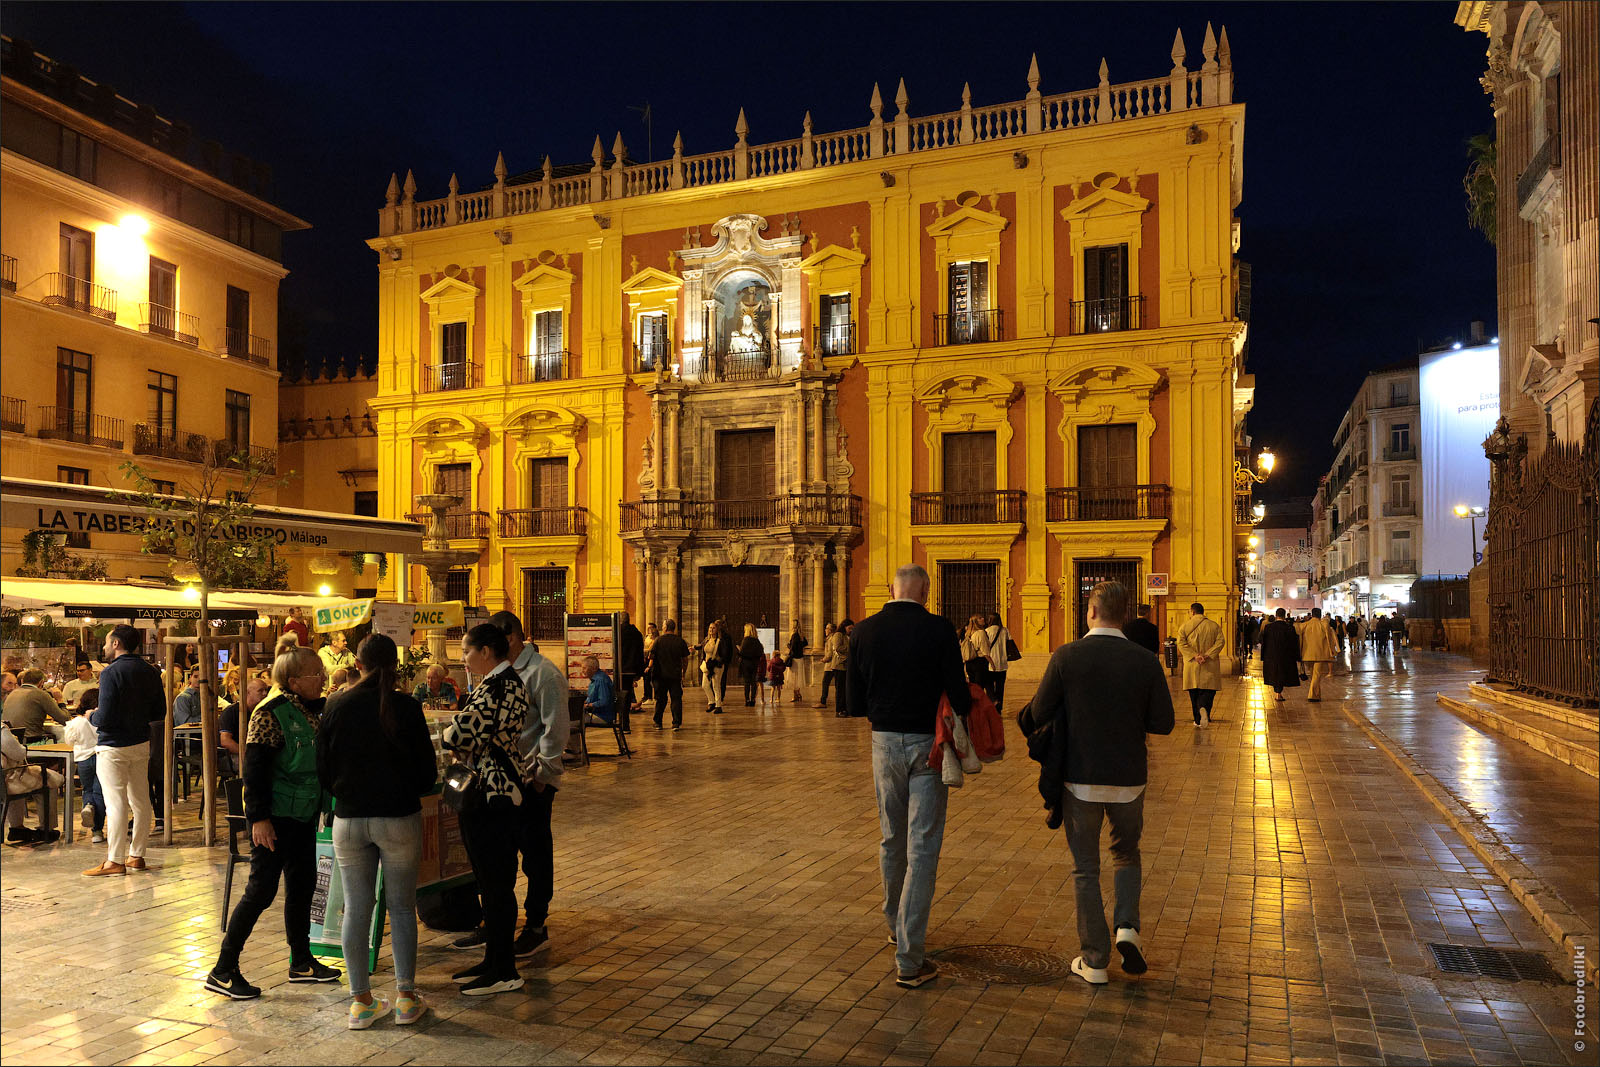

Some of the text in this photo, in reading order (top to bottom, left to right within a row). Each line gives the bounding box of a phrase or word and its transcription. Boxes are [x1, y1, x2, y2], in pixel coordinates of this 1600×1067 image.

[1458, 402, 1500, 414] para prot
[38, 508, 69, 529] LA
[290, 530, 328, 546] Málaga
[136, 609, 201, 618] TATANEGRO
[333, 604, 367, 620] ONCE
[413, 611, 445, 625] ONCE
